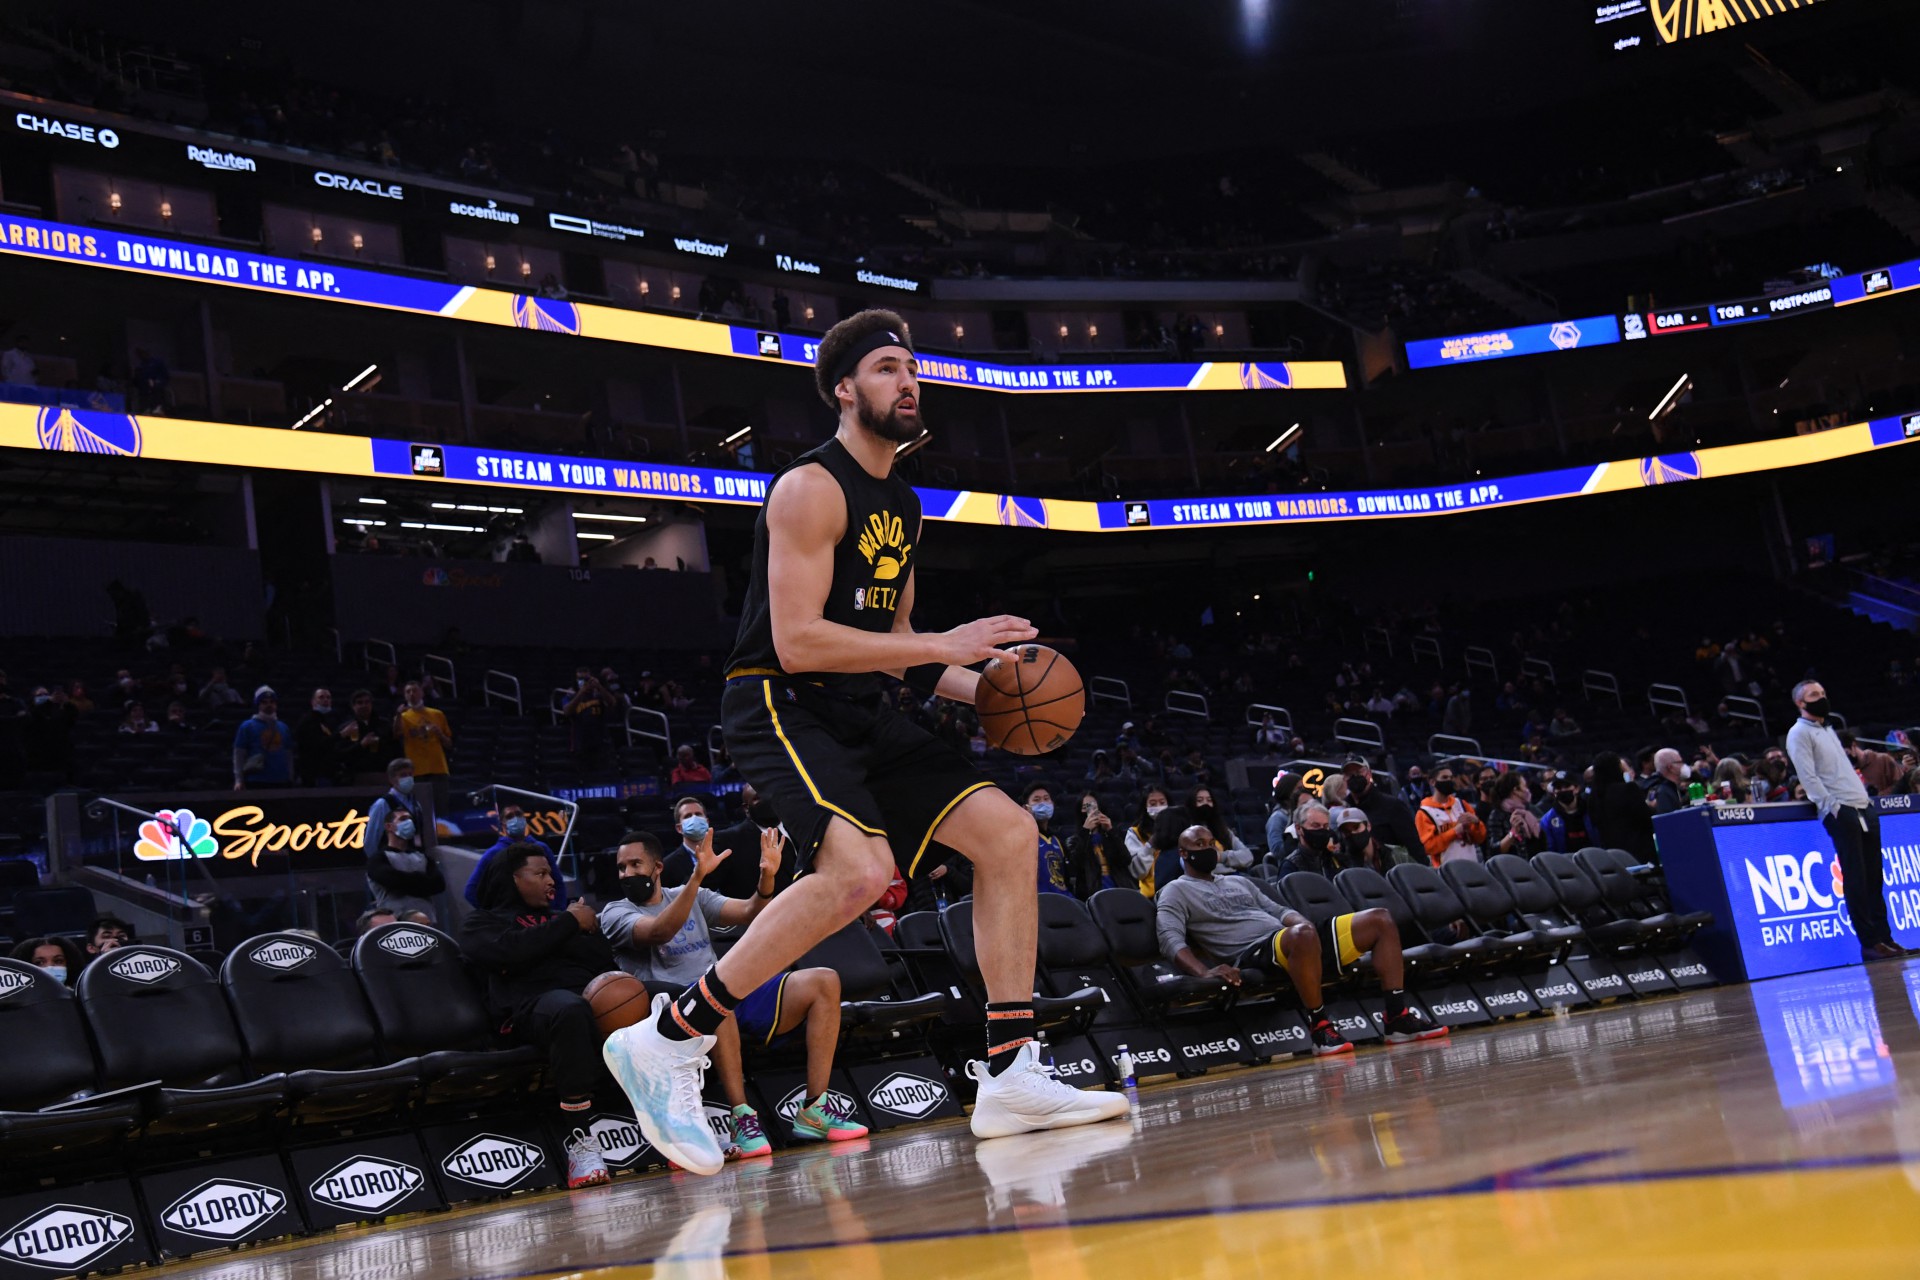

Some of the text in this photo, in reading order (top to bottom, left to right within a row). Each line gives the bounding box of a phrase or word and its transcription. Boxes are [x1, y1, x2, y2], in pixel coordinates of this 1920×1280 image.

[16, 113, 96, 144] CHASE
[187, 145, 256, 172] Rakuten
[314, 172, 403, 199] ORACLE
[450, 202, 519, 224] accenture
[0, 222, 341, 293] ARRIORS. DOWNLOAD THE APP.
[674, 238, 725, 257] verizon
[793, 260, 820, 275] Adobe
[856, 270, 918, 291] ticketmaster
[1717, 305, 1745, 319] TOR
[1770, 288, 1831, 312] POSTPONED
[1657, 313, 1684, 327] CAR
[917, 360, 1117, 386] ARRIORS. DOWNLOAD THE APP.
[476, 456, 552, 482] STREAM
[559, 463, 606, 486] YOUR
[613, 468, 707, 493] WARRIORS.
[1173, 485, 1503, 522] STREAM YOUR WARRIORS. DOWNLOAD THE APP.
[567, 569, 591, 581] 104
[1880, 797, 1906, 809] CHASE
[1718, 808, 1746, 820] CHASE
[213, 806, 369, 868] Sports
[1881, 845, 1920, 886] CHAN
[1745, 851, 1833, 915] NBC
[192, 930, 202, 943] 6
[386, 934, 431, 950] CLOROX
[1761, 919, 1844, 946] BAY AREA
[258, 946, 309, 964] CLOROX
[118, 957, 173, 976] CLOROX
[1671, 966, 1699, 978] CHASE
[1584, 977, 1613, 991] CHASE
[1627, 971, 1655, 984] CHASE
[1484, 993, 1519, 1007] CHASE
[1535, 984, 1570, 999] CHASE
[1432, 1001, 1469, 1016] CHASE
[1252, 1028, 1295, 1045] CHASE
[1112, 1049, 1159, 1066] CASE
[1182, 1039, 1228, 1058] CHASE
[1051, 1061, 1082, 1078] ASE
[877, 1081, 941, 1109] CLOROX
[600, 1123, 649, 1151] OROX
[455, 1144, 536, 1177] CLOROX
[325, 1166, 413, 1202] CLOROX
[176, 1188, 274, 1230] CLOROX
[13, 1215, 120, 1259] CLOROX
